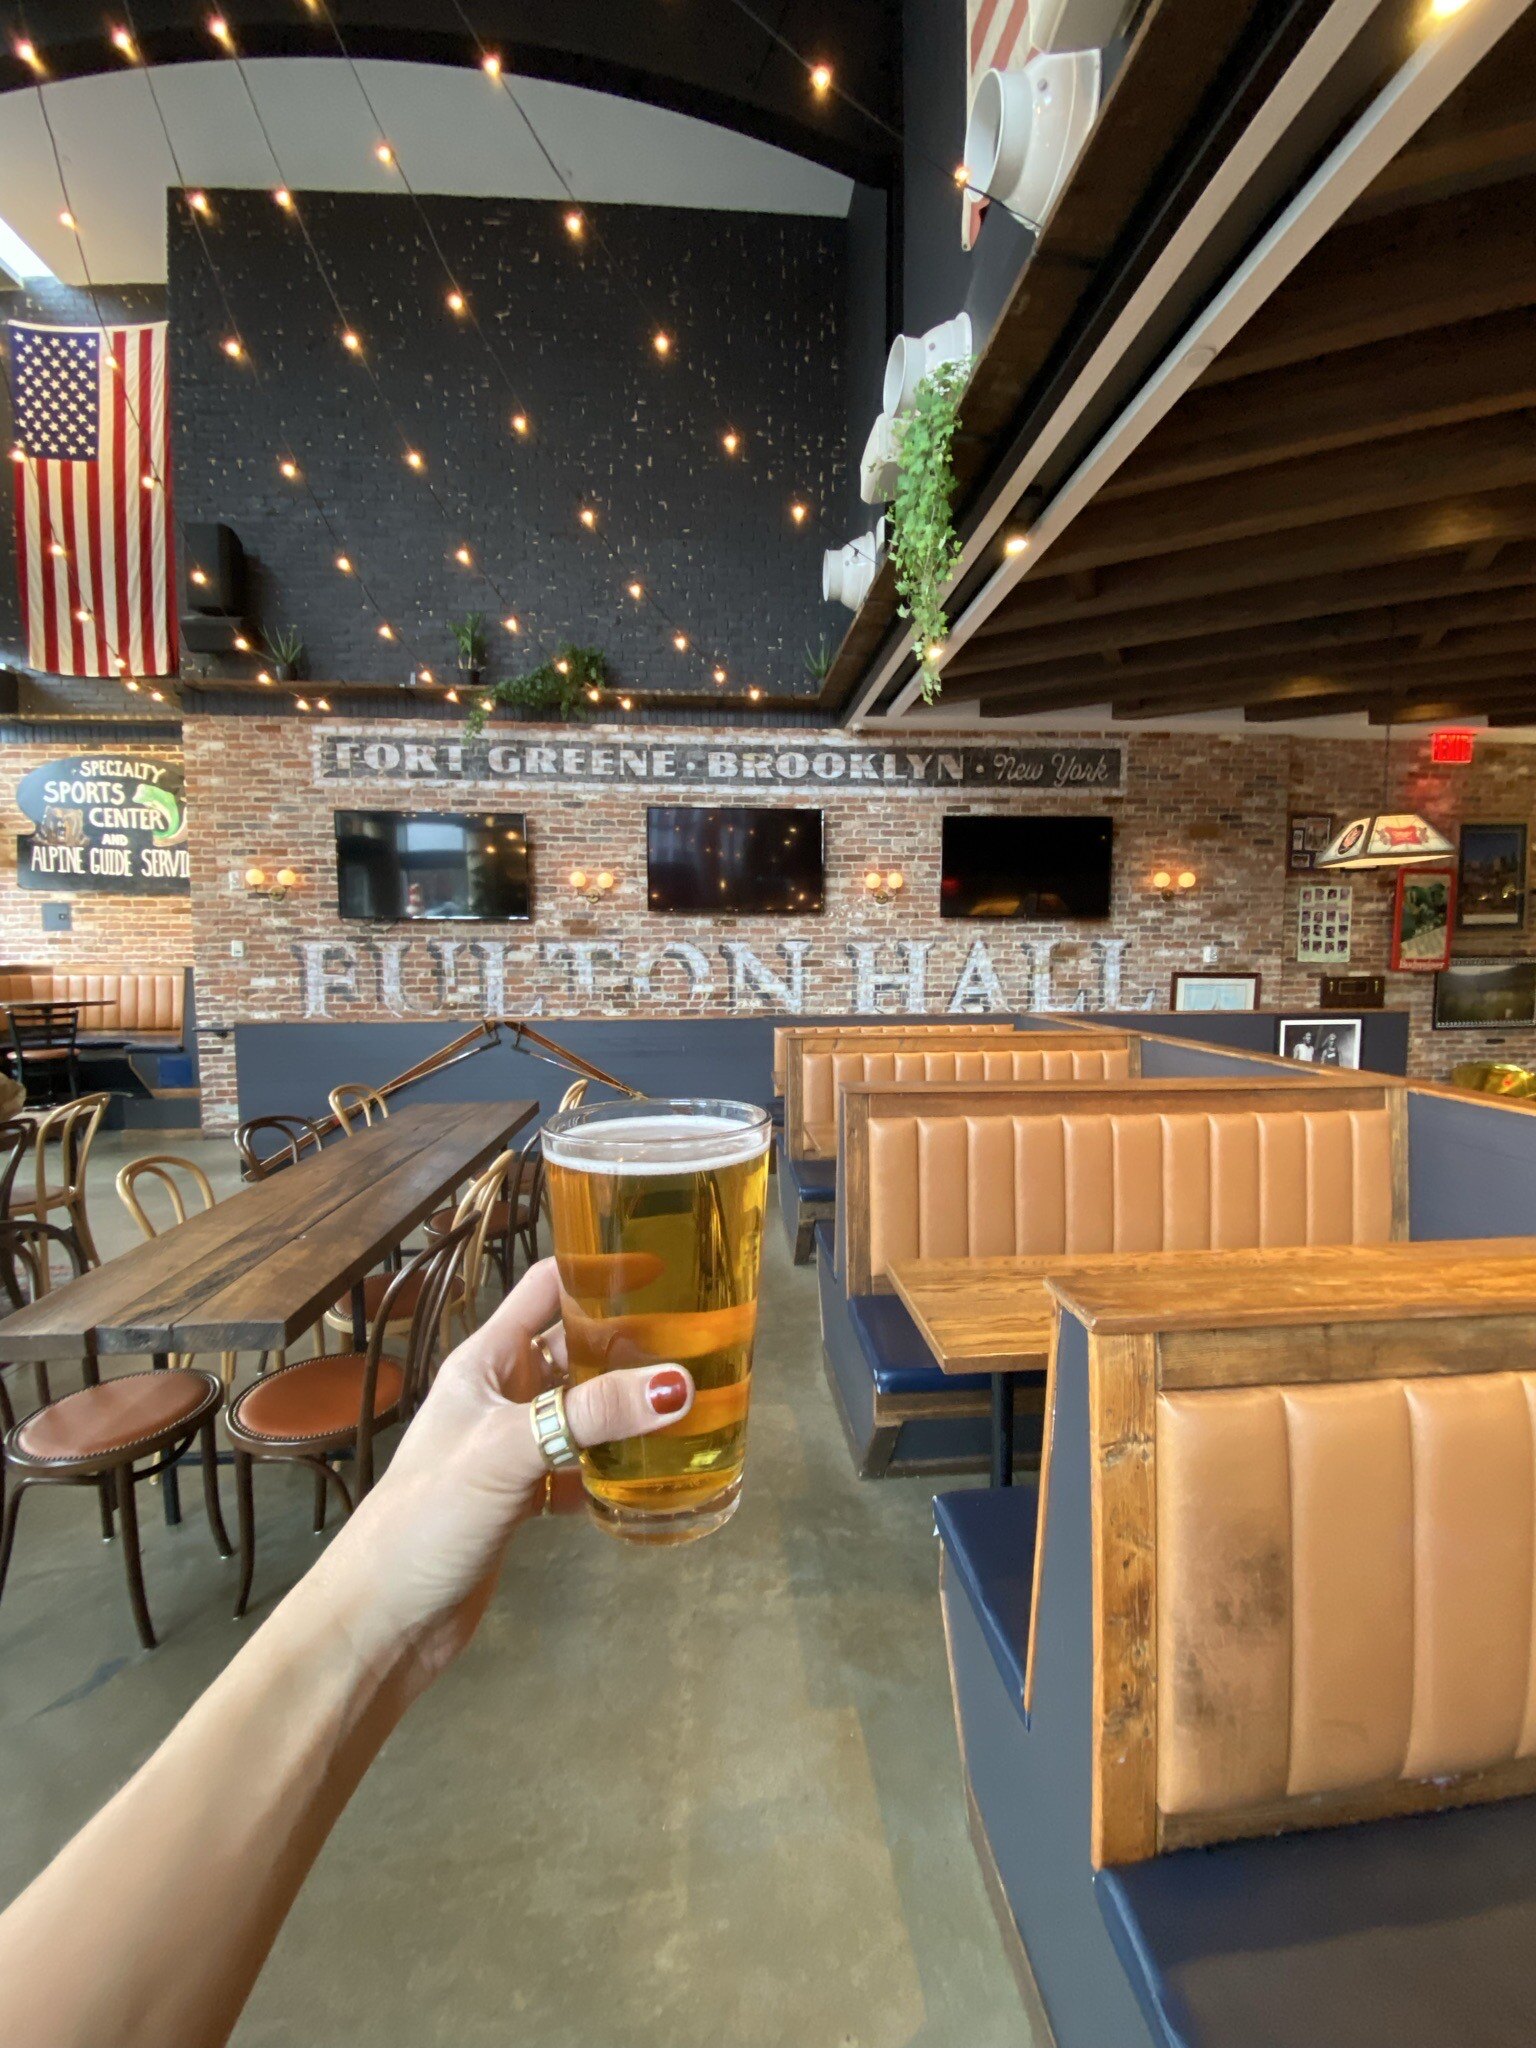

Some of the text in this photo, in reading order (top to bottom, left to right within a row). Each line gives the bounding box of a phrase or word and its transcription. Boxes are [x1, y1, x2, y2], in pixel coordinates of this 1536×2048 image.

[79, 760, 166, 783] SPECIALTY
[334, 743, 1110, 788] FORT GREENE BROOKLYN New York
[43, 781, 126, 805] SPORTS
[88, 807, 165, 830] CENTER
[101, 833, 129, 846] AND
[31, 845, 86, 874] ALPINE
[89, 848, 133, 877] GUIDE
[301, 937, 1157, 1019] FULTON HALL
